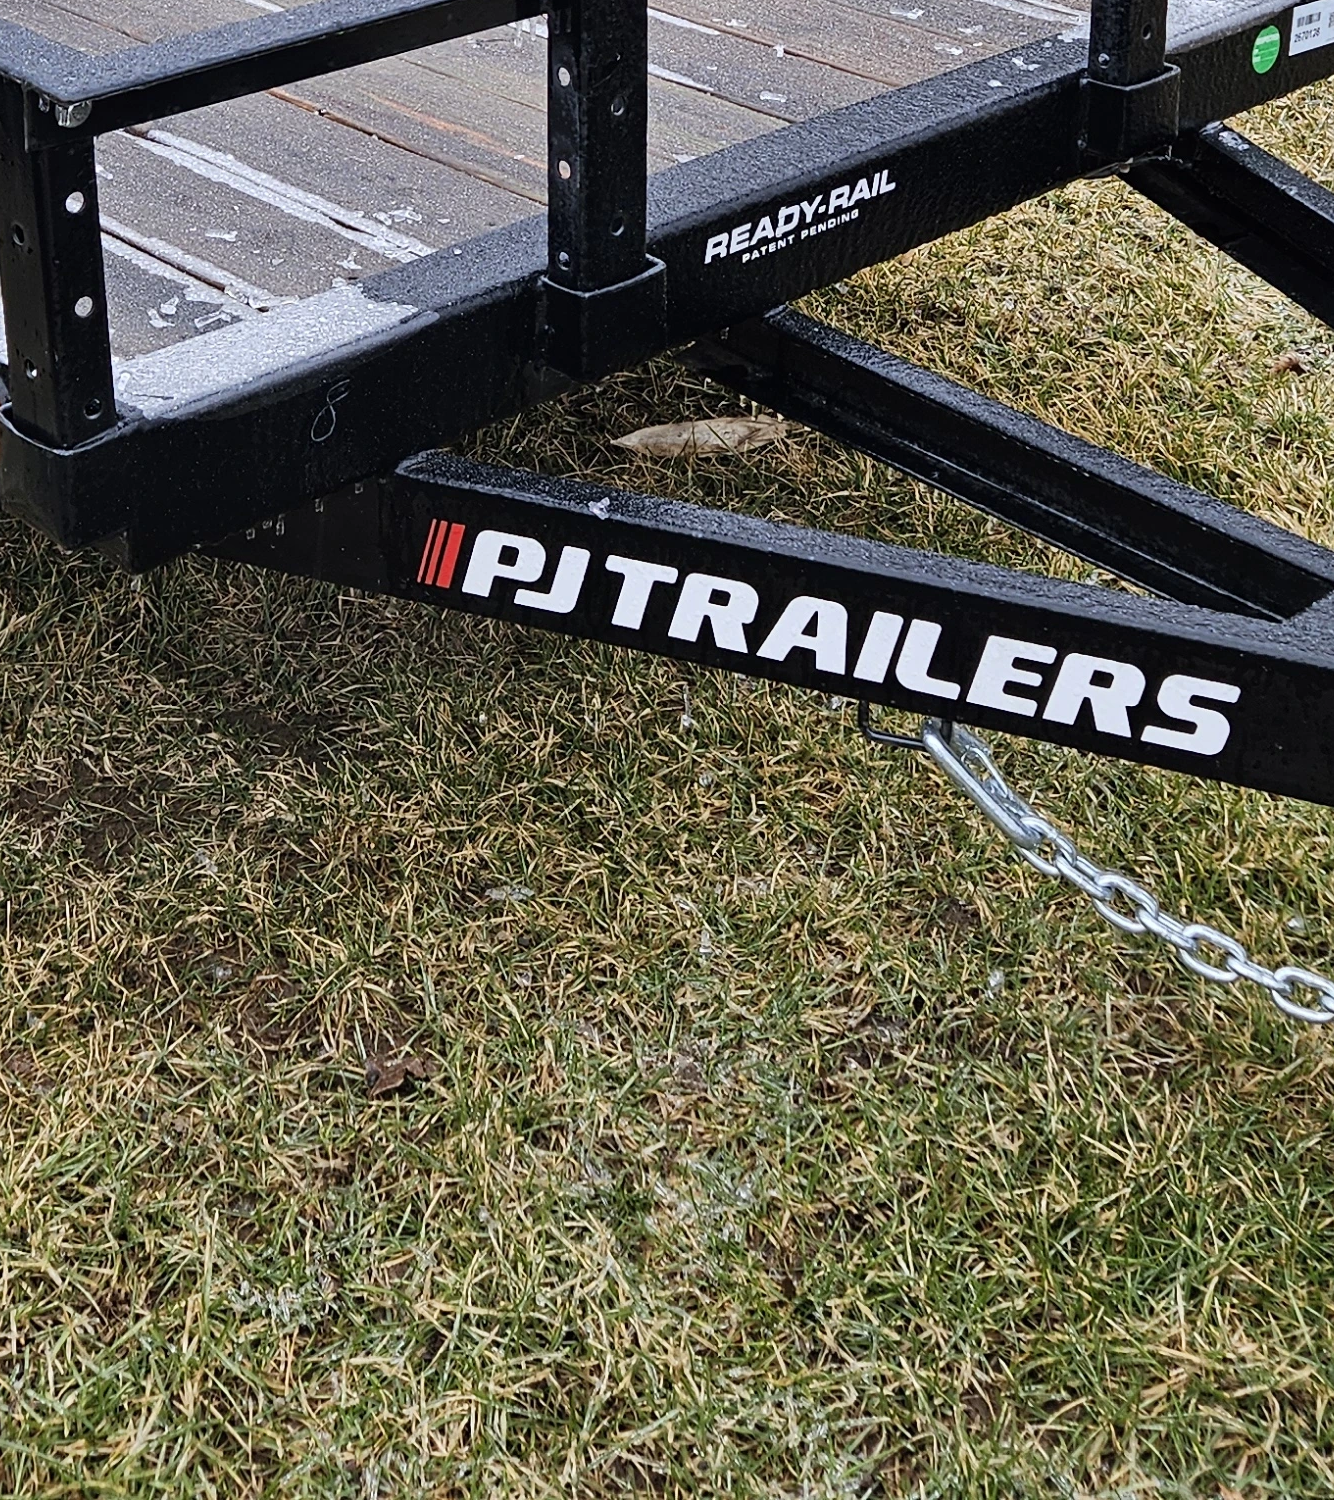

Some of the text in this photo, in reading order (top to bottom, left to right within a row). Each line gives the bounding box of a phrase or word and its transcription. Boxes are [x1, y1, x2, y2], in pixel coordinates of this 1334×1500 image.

[704, 169, 896, 264] READY-RAIL
[742, 208, 860, 264] PATENT PENDING
[462, 530, 1242, 756] PJ TRAILERS
